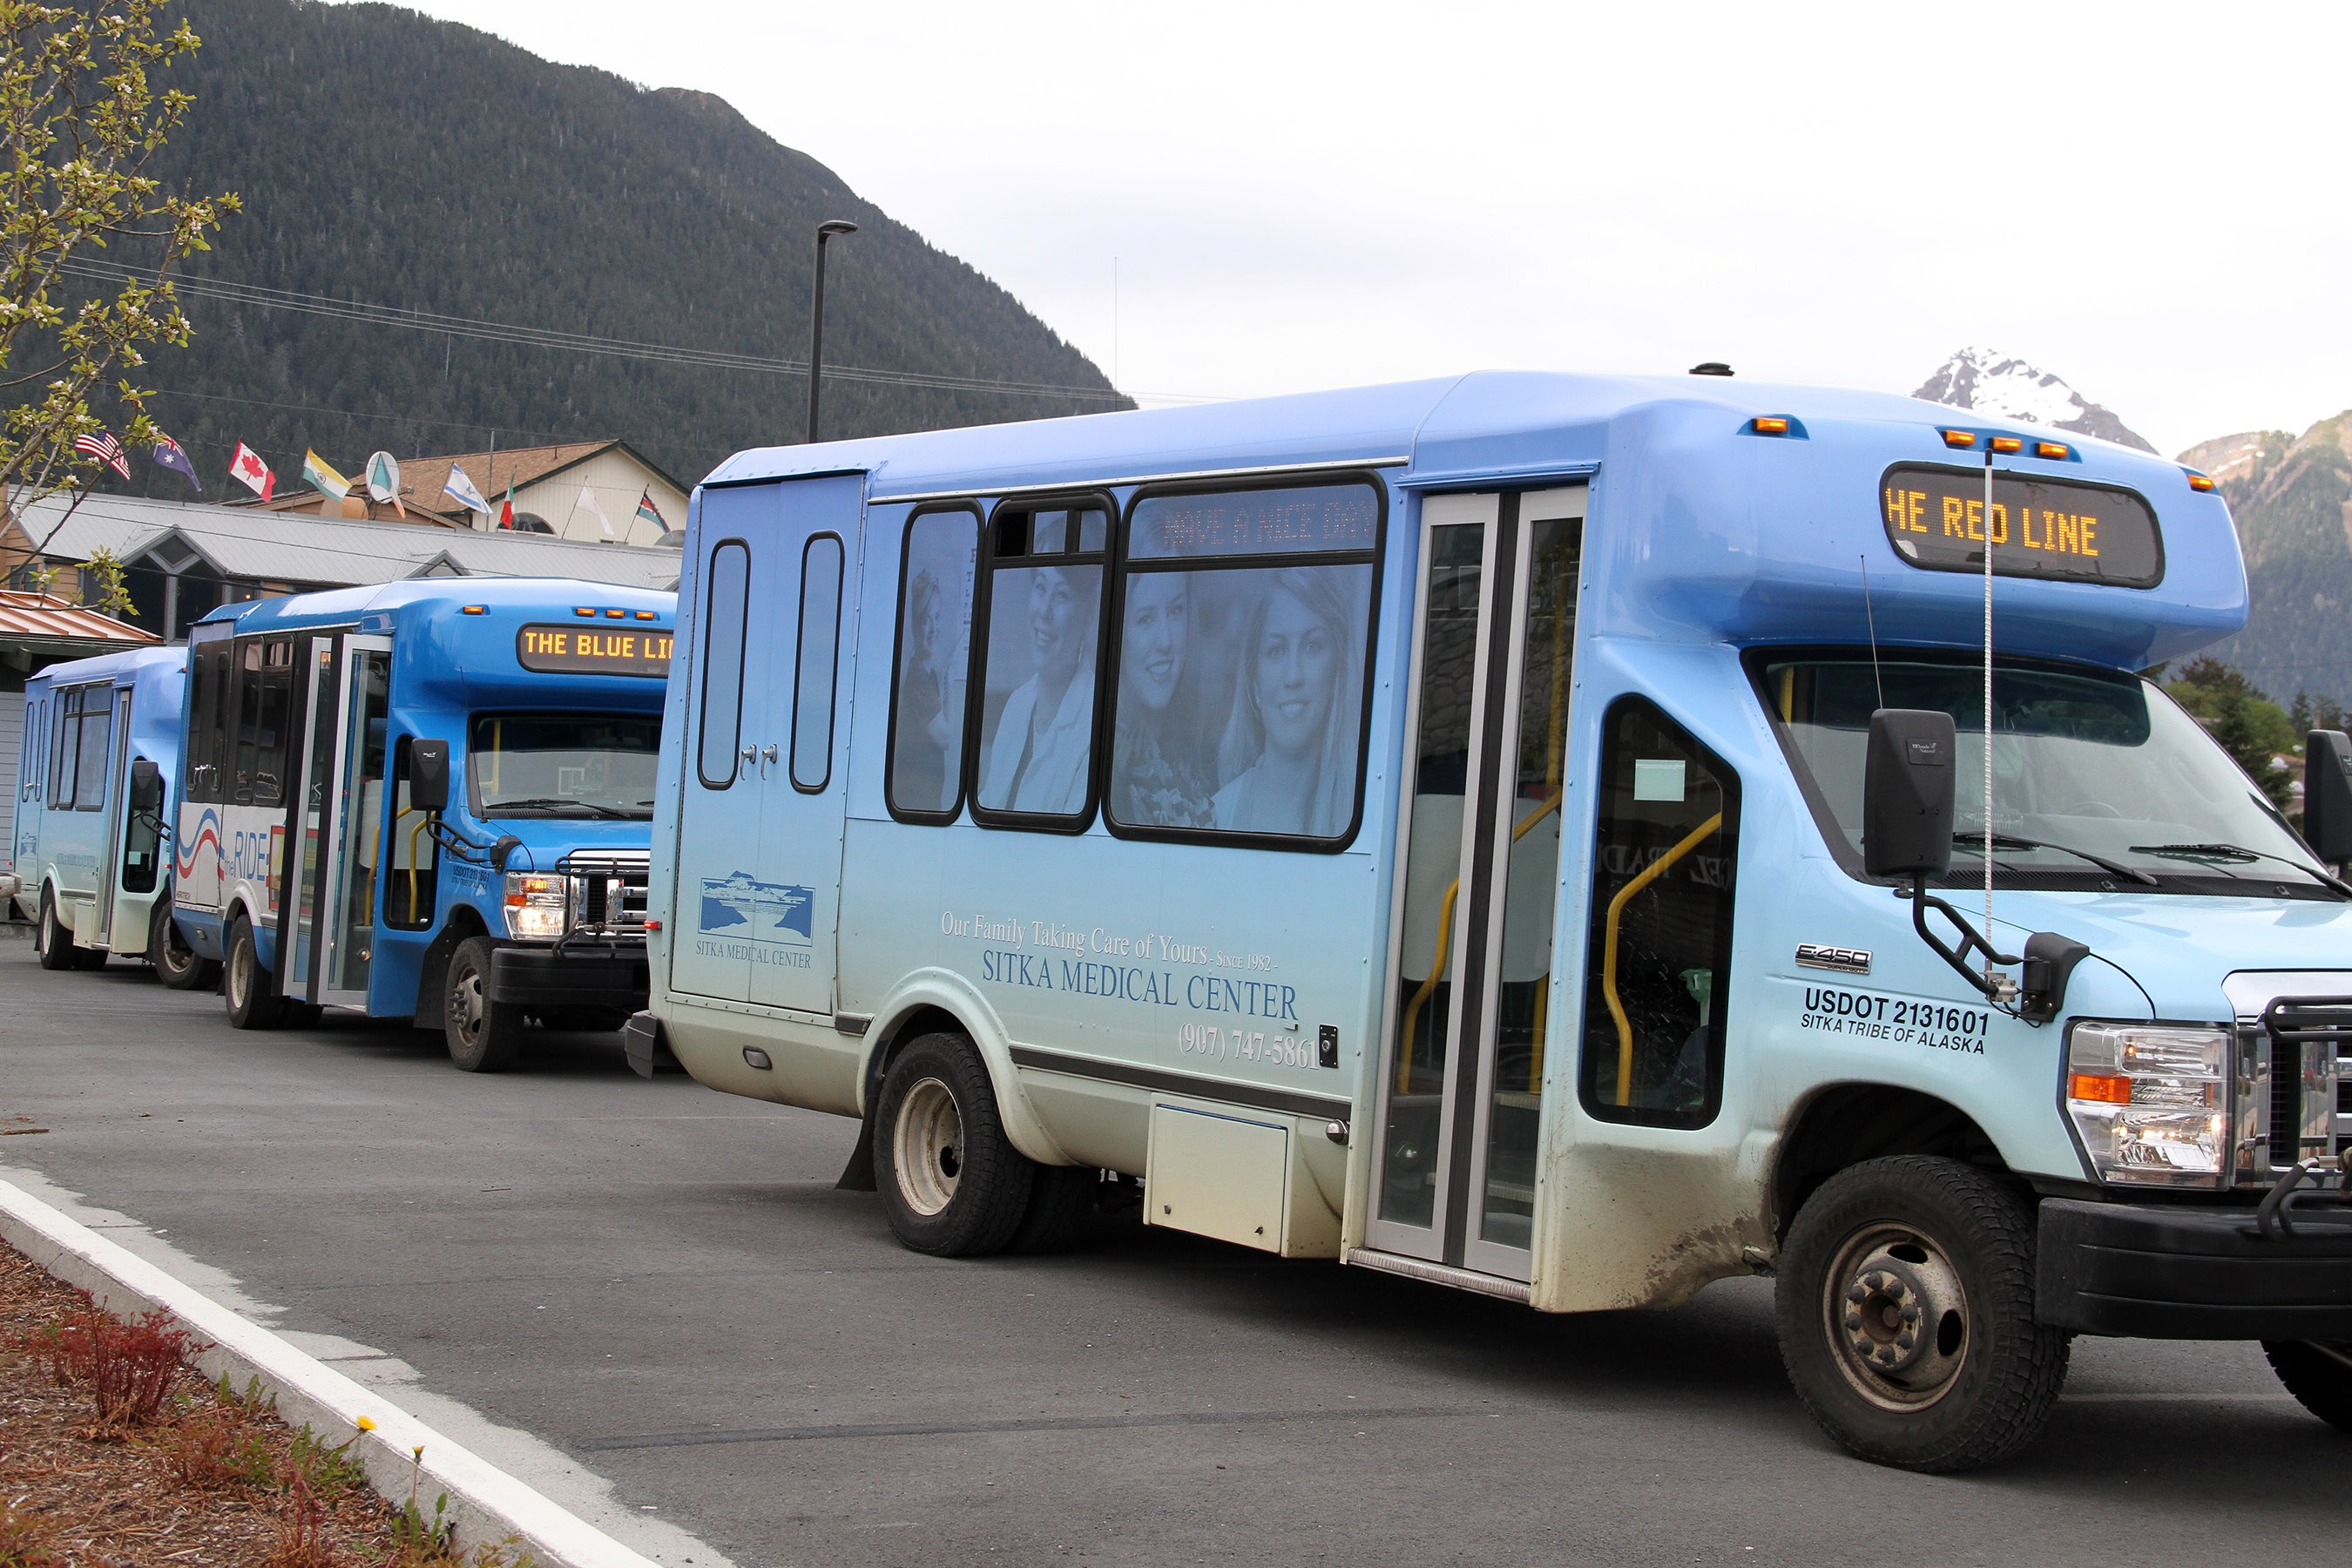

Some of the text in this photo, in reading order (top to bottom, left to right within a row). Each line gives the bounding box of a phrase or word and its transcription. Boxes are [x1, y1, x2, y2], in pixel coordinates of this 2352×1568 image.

[1943, 496, 2008, 544] RED
[2023, 508, 2099, 556] LINE
[525, 632, 567, 654] THE
[577, 634, 635, 658] BLUE
[234, 831, 267, 882] RIDE
[696, 940, 811, 970] SITKA MEDICAL CENTER
[941, 911, 970, 937] Our
[974, 915, 1027, 950] Family
[1031, 921, 1086, 958] Taking
[1091, 928, 1130, 957] Care
[1135, 933, 1155, 959] of
[1159, 935, 1208, 965] Yours
[1247, 954, 1272, 972] 1982
[983, 950, 1300, 1021] SITKA MEDICAL CENTER
[1801, 1013, 1984, 1055] SITKA TRIBE OF ALASKA
[1805, 988, 1990, 1036] USDOT 2131601
[1179, 1022, 1320, 1071] (907) 747-5861
